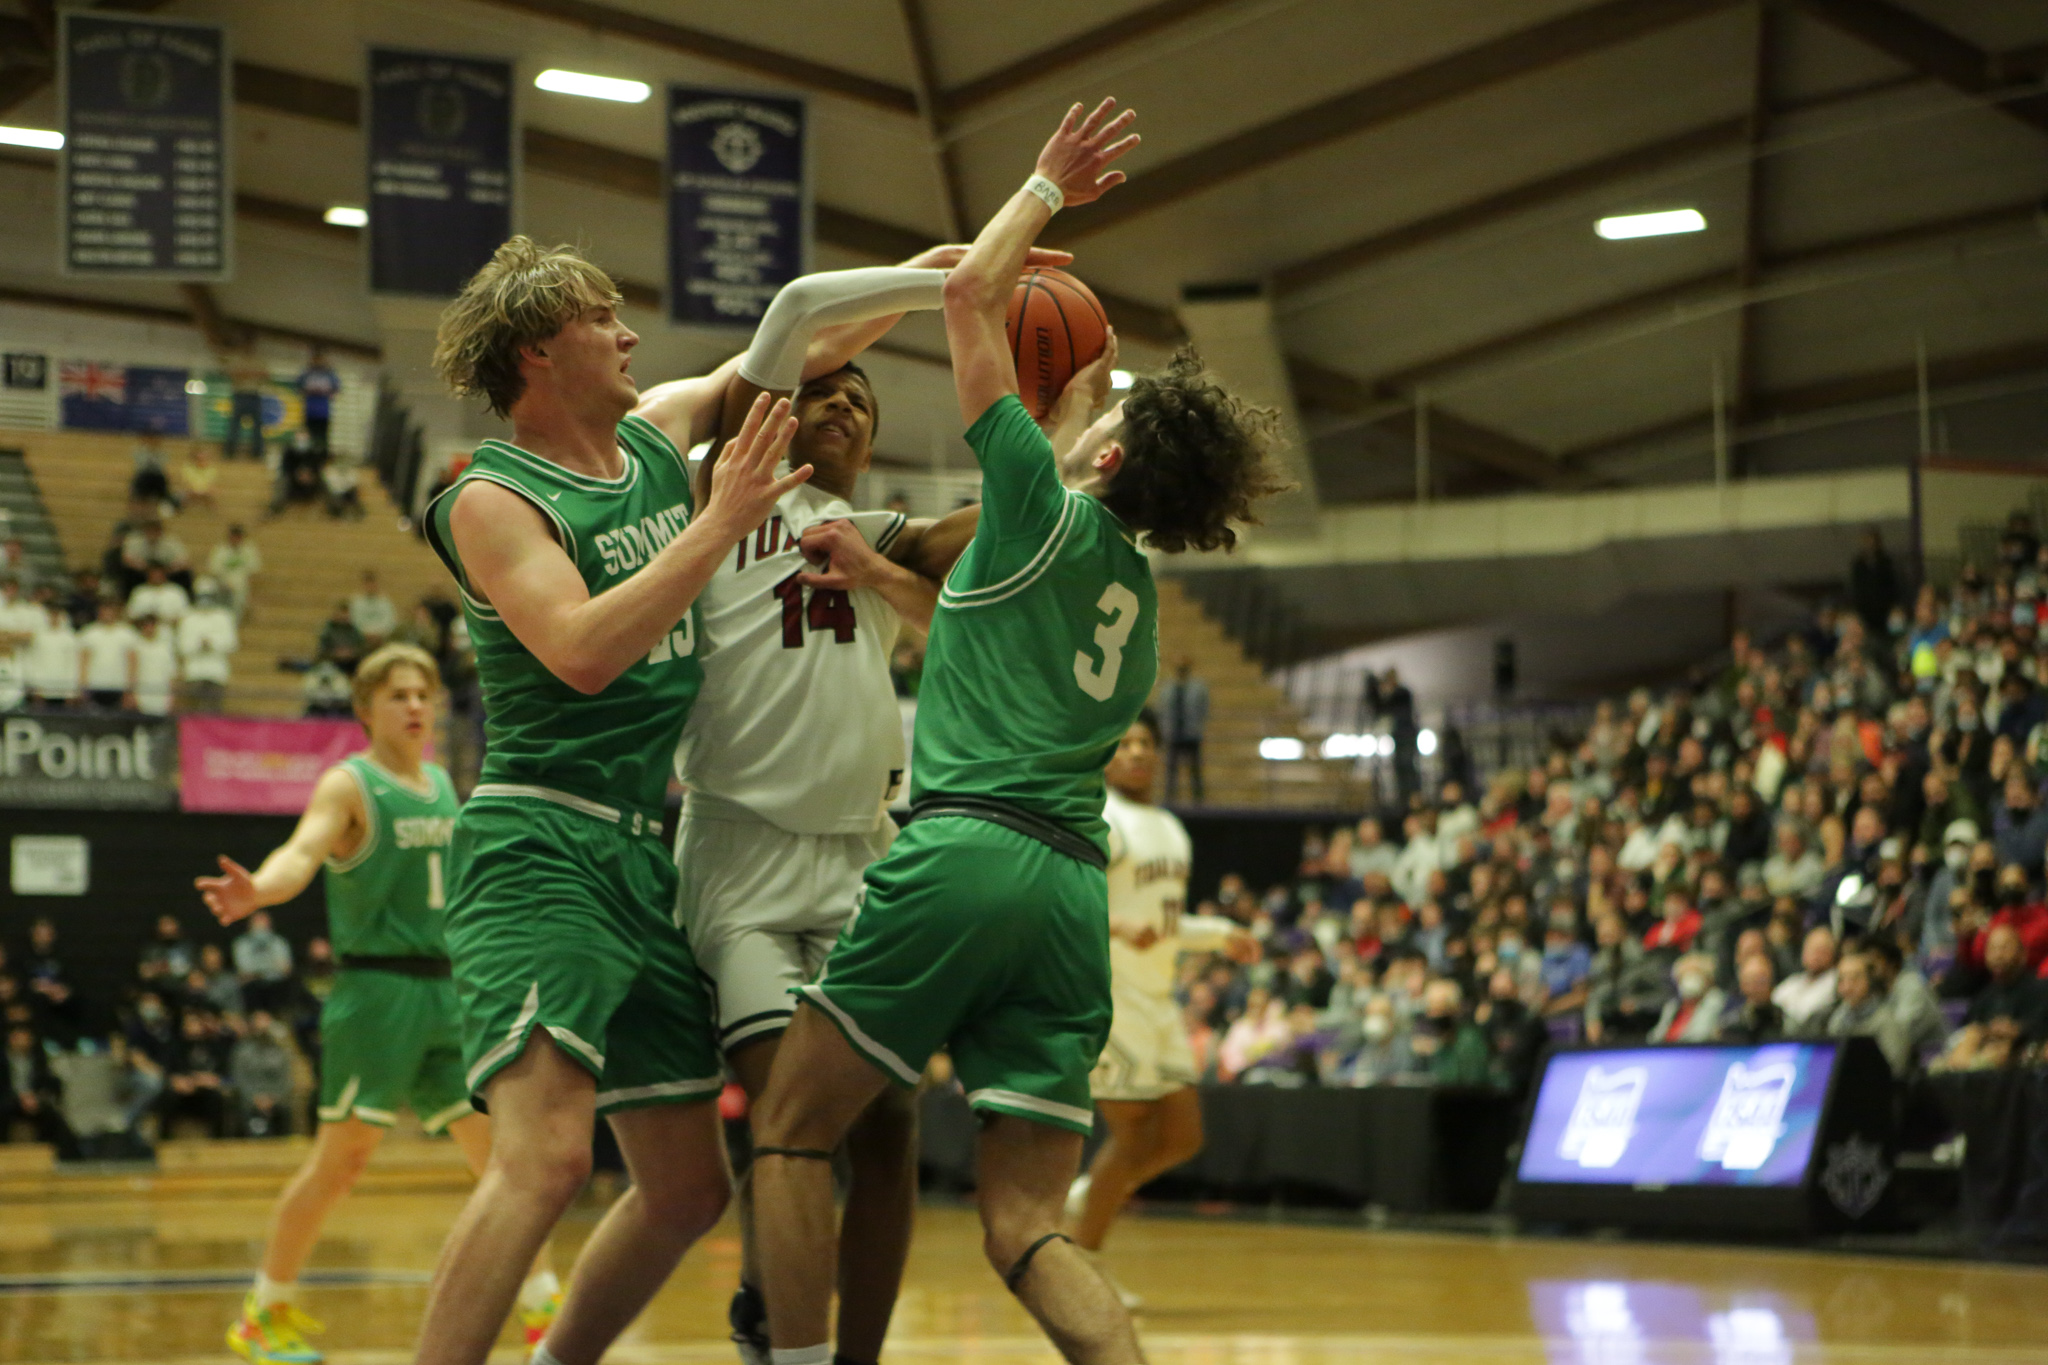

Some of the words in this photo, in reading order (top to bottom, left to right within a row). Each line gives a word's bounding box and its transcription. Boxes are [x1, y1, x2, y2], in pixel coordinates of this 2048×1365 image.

[773, 570, 857, 649] 14
[1073, 581, 1139, 702] 3
[0, 718, 156, 780] Point
[427, 851, 446, 909] 1
